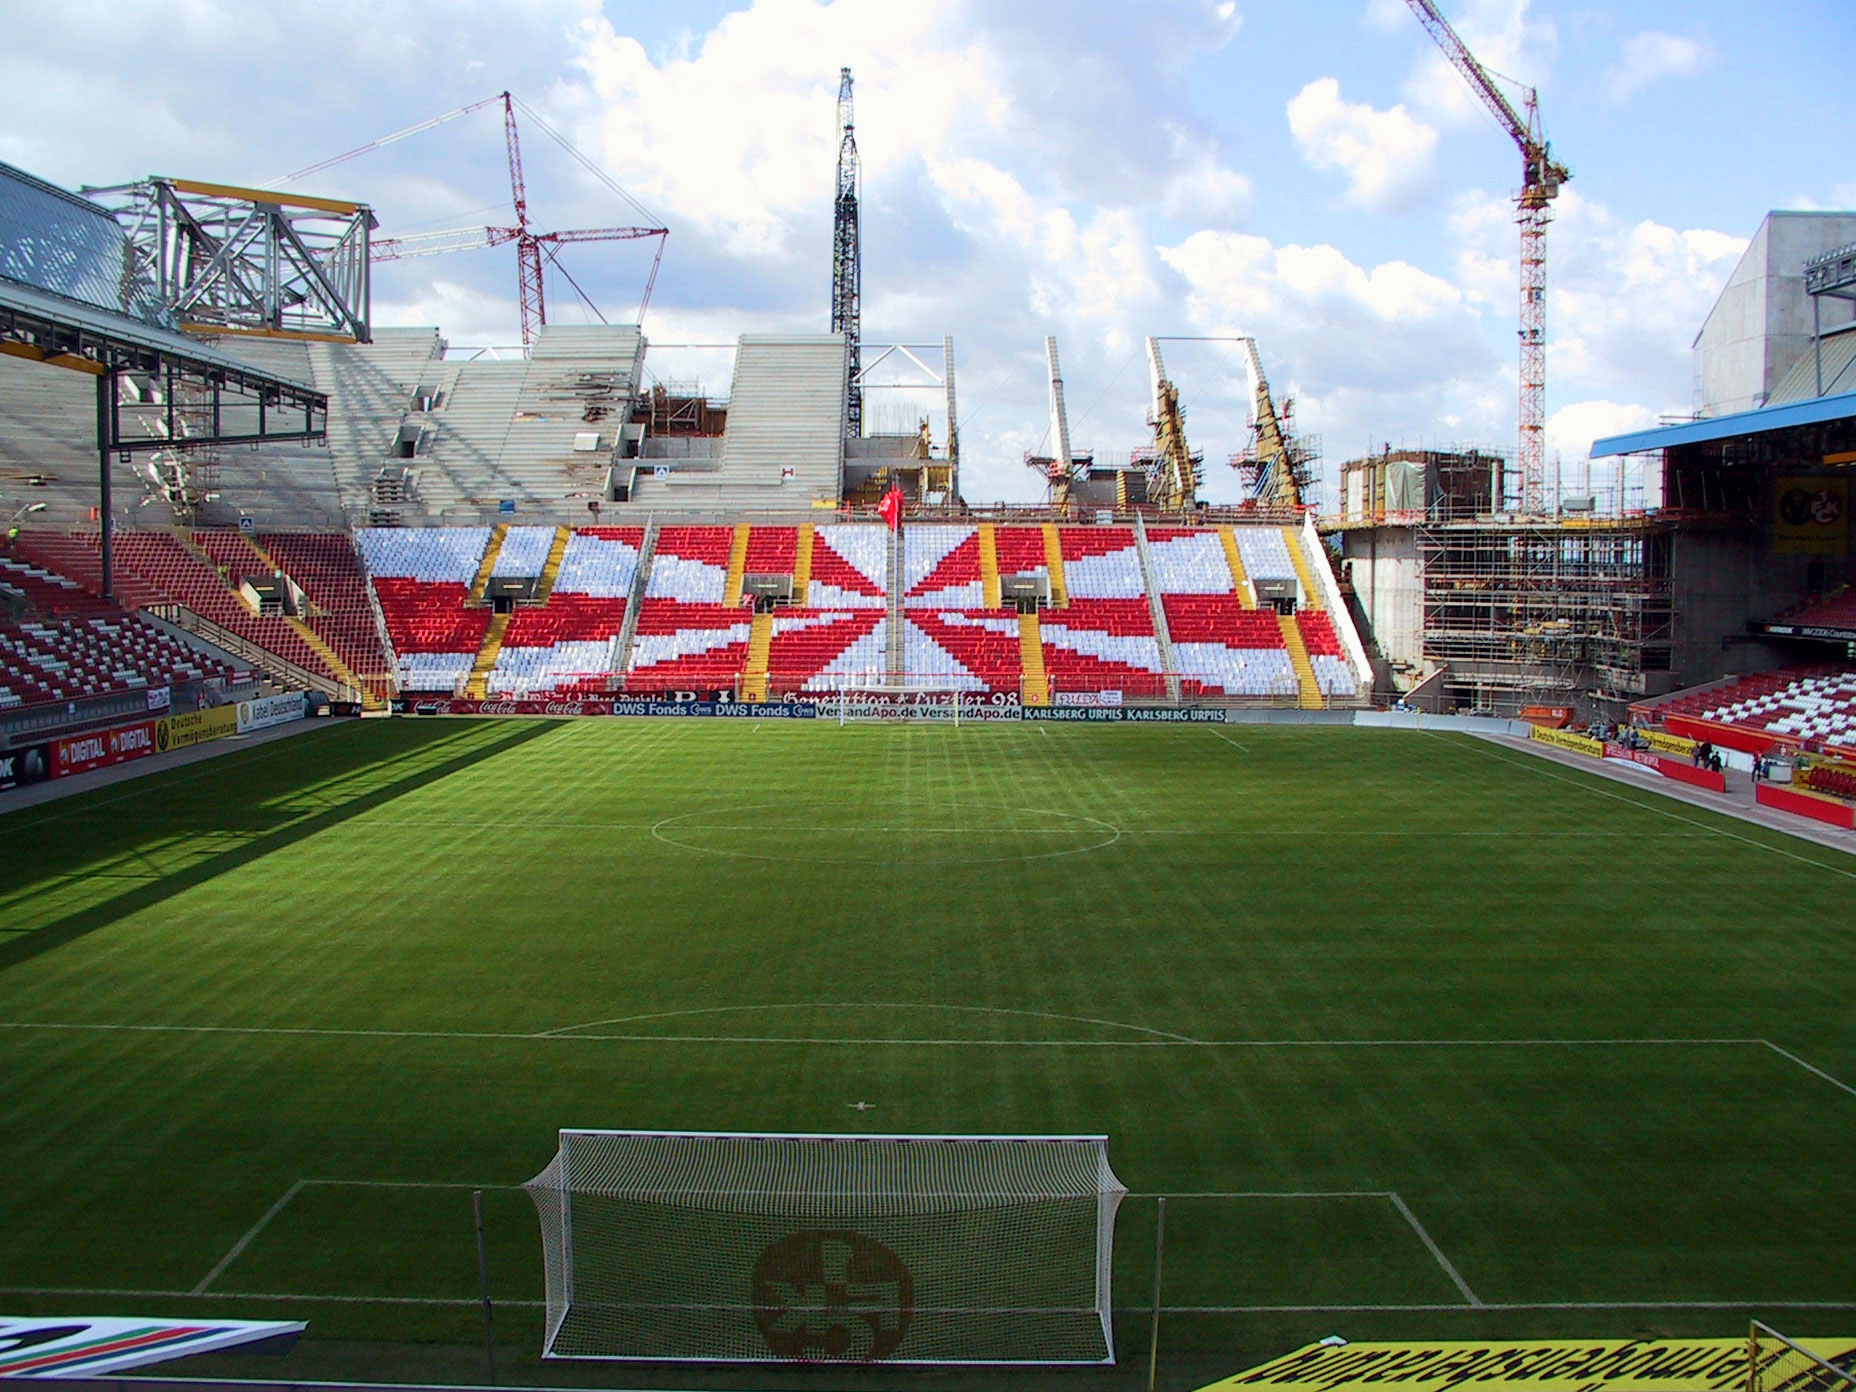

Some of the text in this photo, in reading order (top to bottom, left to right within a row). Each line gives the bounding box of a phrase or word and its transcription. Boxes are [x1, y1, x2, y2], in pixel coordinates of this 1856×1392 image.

[613, 703, 687, 715] DWS Fonds
[716, 704, 789, 717] DWS Fonds
[1024, 709, 1086, 720] KARLSBERG
[1127, 709, 1188, 720] KARLSBERG
[171, 714, 202, 730] Deutsche
[70, 727, 151, 764] DIGITAL DIGITAL
